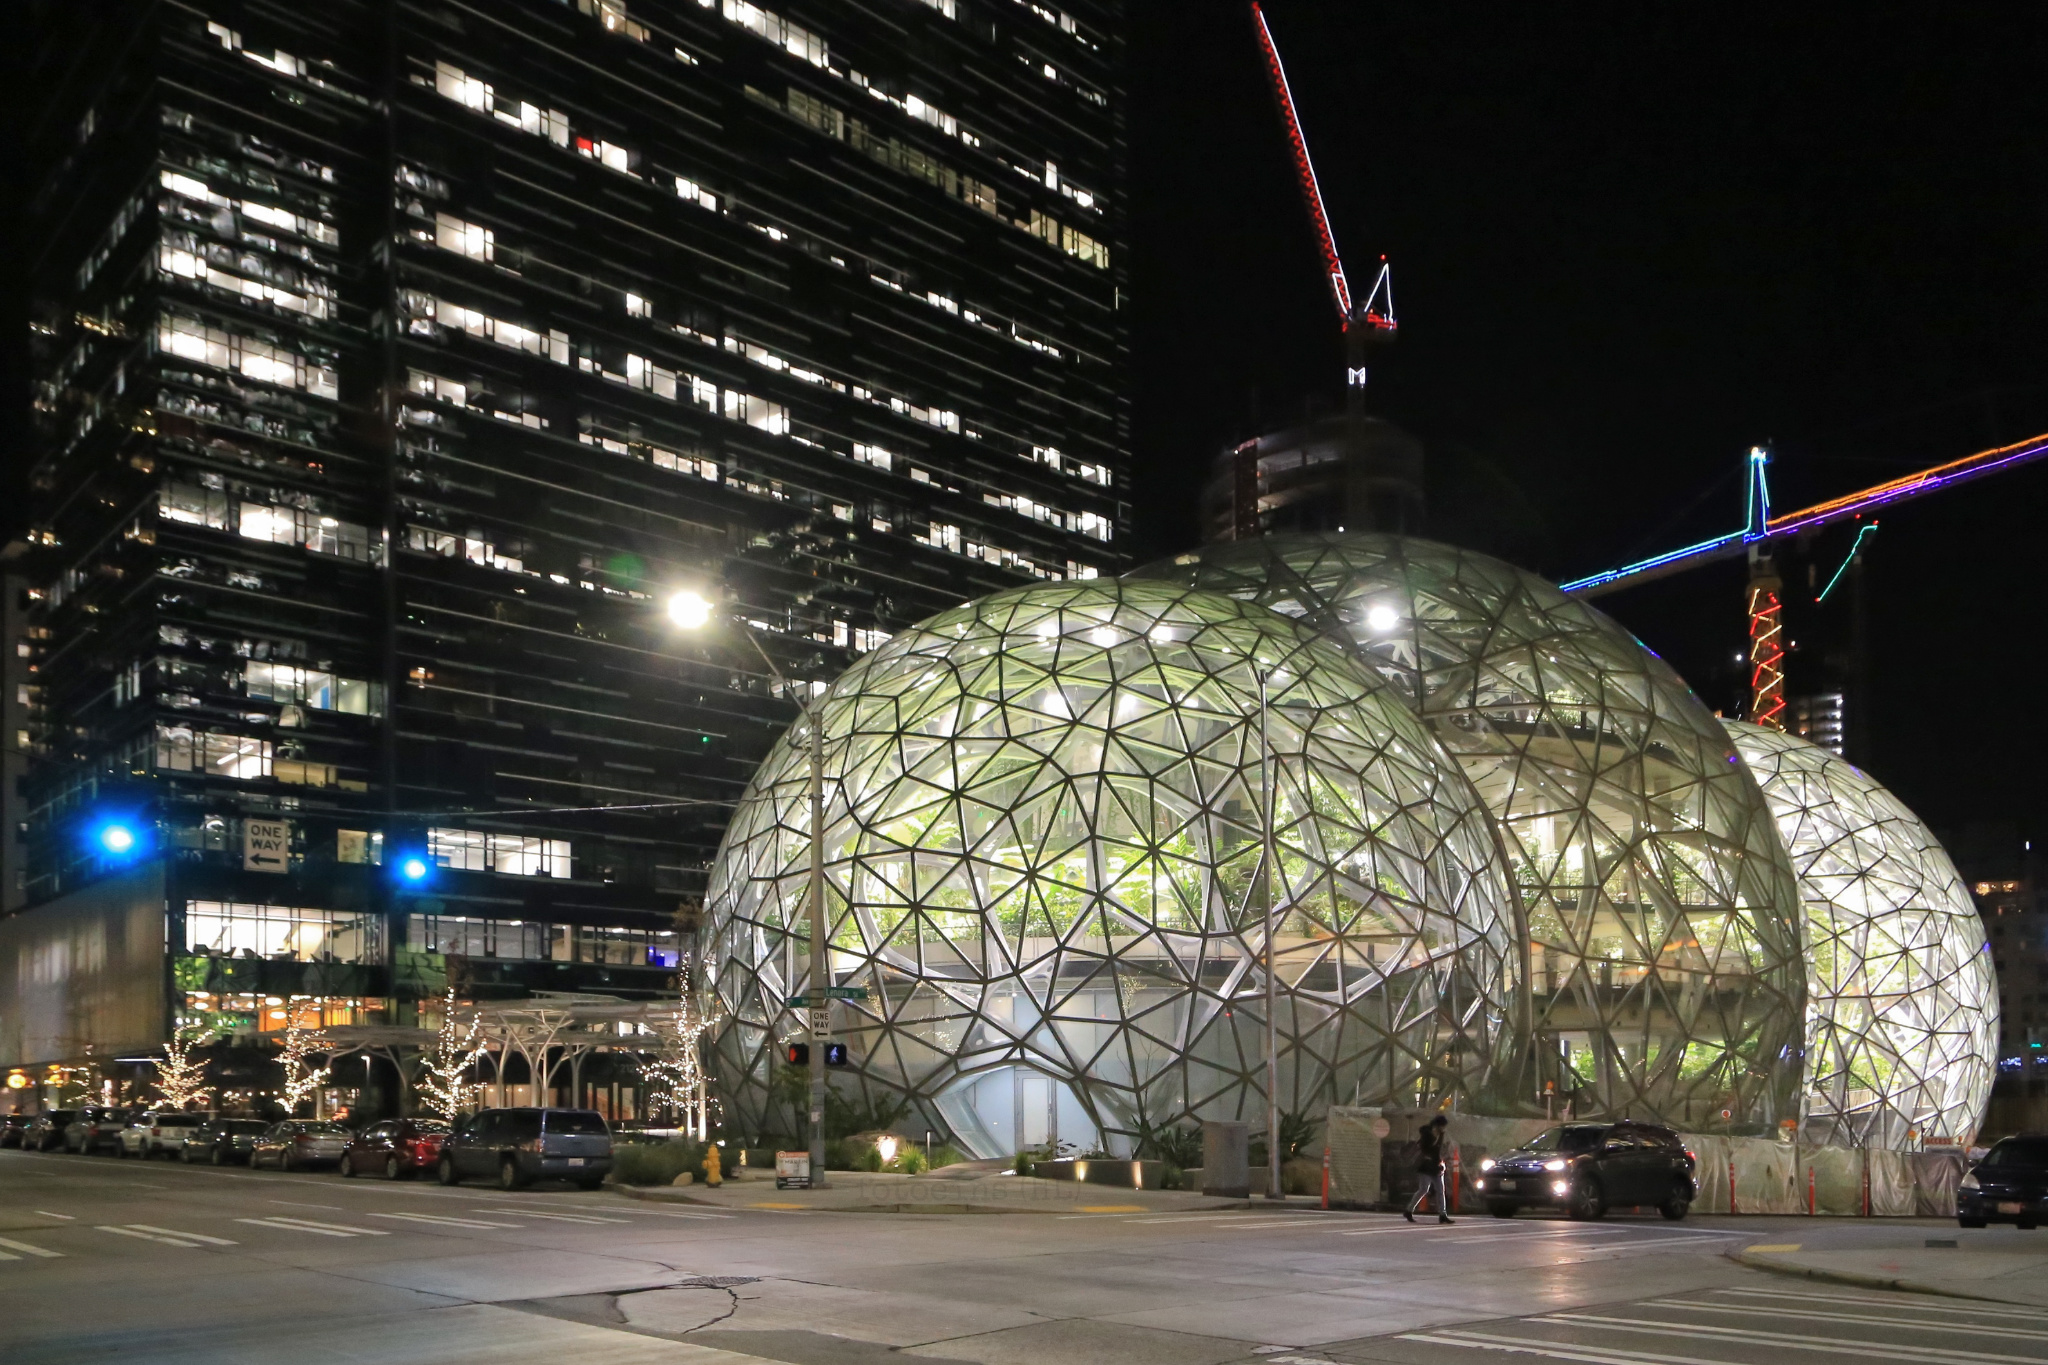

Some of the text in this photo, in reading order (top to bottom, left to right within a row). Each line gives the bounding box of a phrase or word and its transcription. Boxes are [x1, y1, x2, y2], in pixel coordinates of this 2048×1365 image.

[251, 824, 282, 838] ONE
[251, 838, 282, 851] WAY
[825, 987, 849, 998] Lenora
[813, 1012, 829, 1020] ONE
[813, 1021, 830, 1029] WAY
[1925, 1137, 1952, 1145] ACCESS
